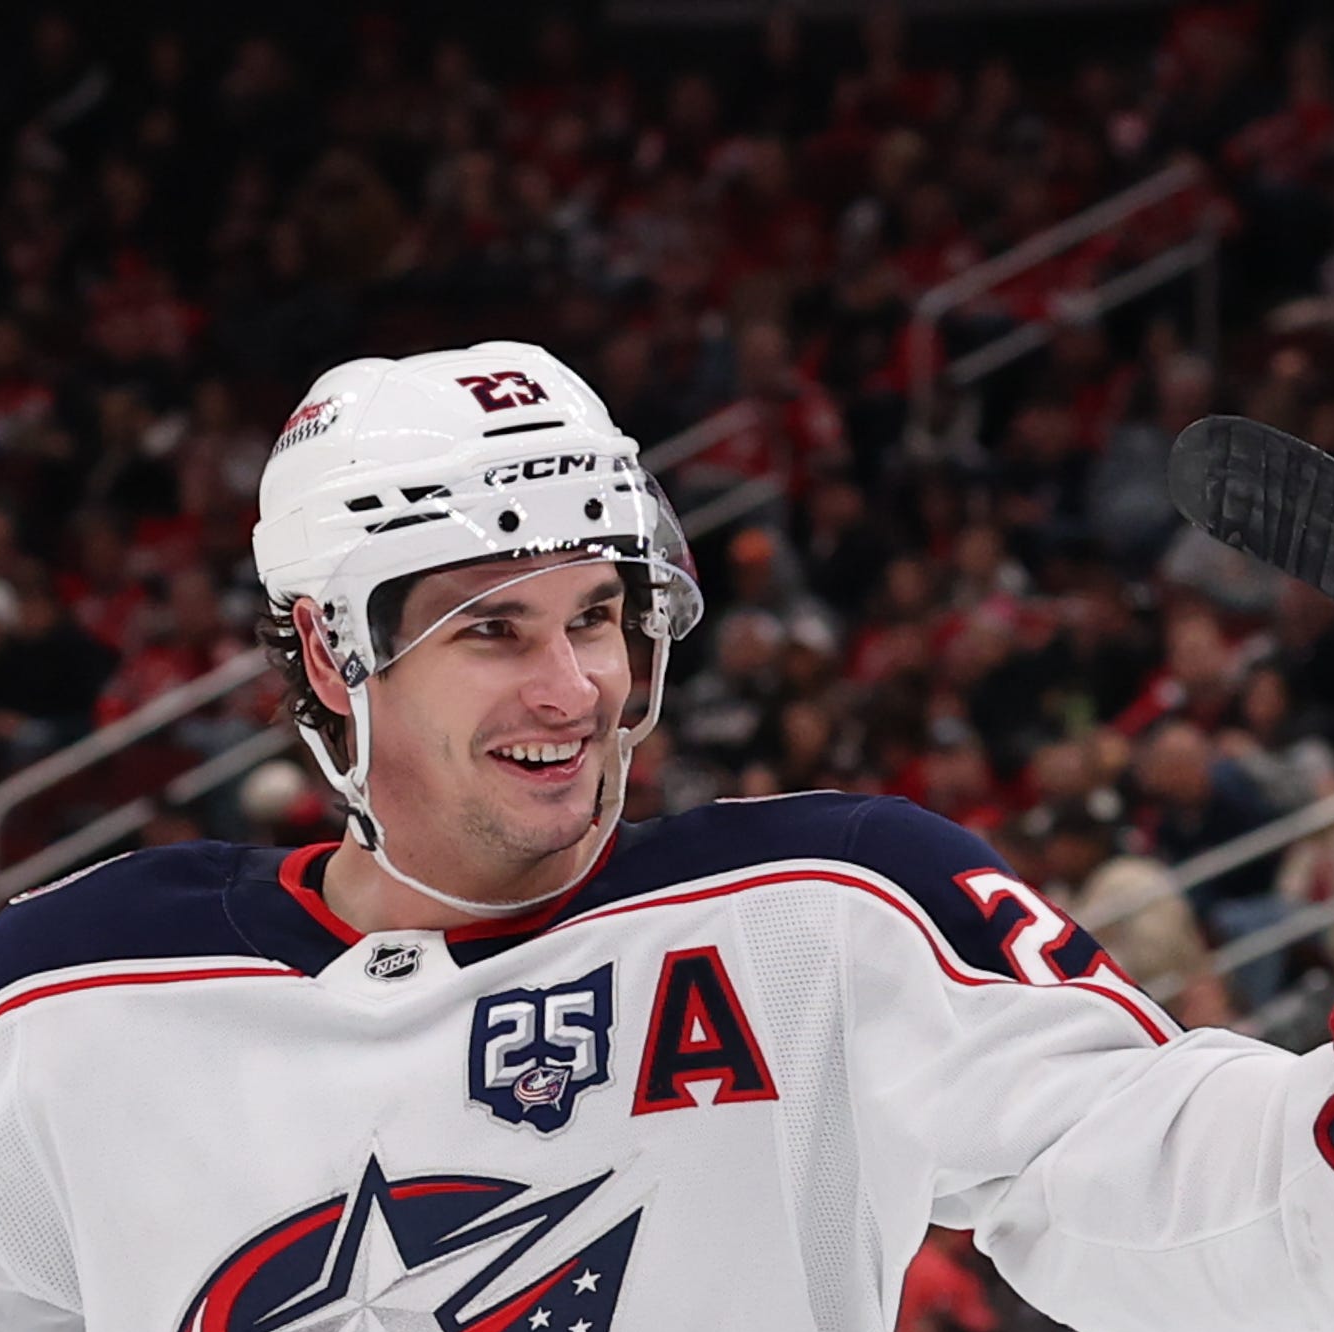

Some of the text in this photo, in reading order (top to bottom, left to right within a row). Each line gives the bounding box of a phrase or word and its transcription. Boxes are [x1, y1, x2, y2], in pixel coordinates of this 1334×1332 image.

[455, 371, 550, 413] 23
[484, 454, 597, 487] CCM
[373, 954, 417, 976] NHL
[484, 990, 598, 1089] 25
[630, 944, 780, 1117] A
